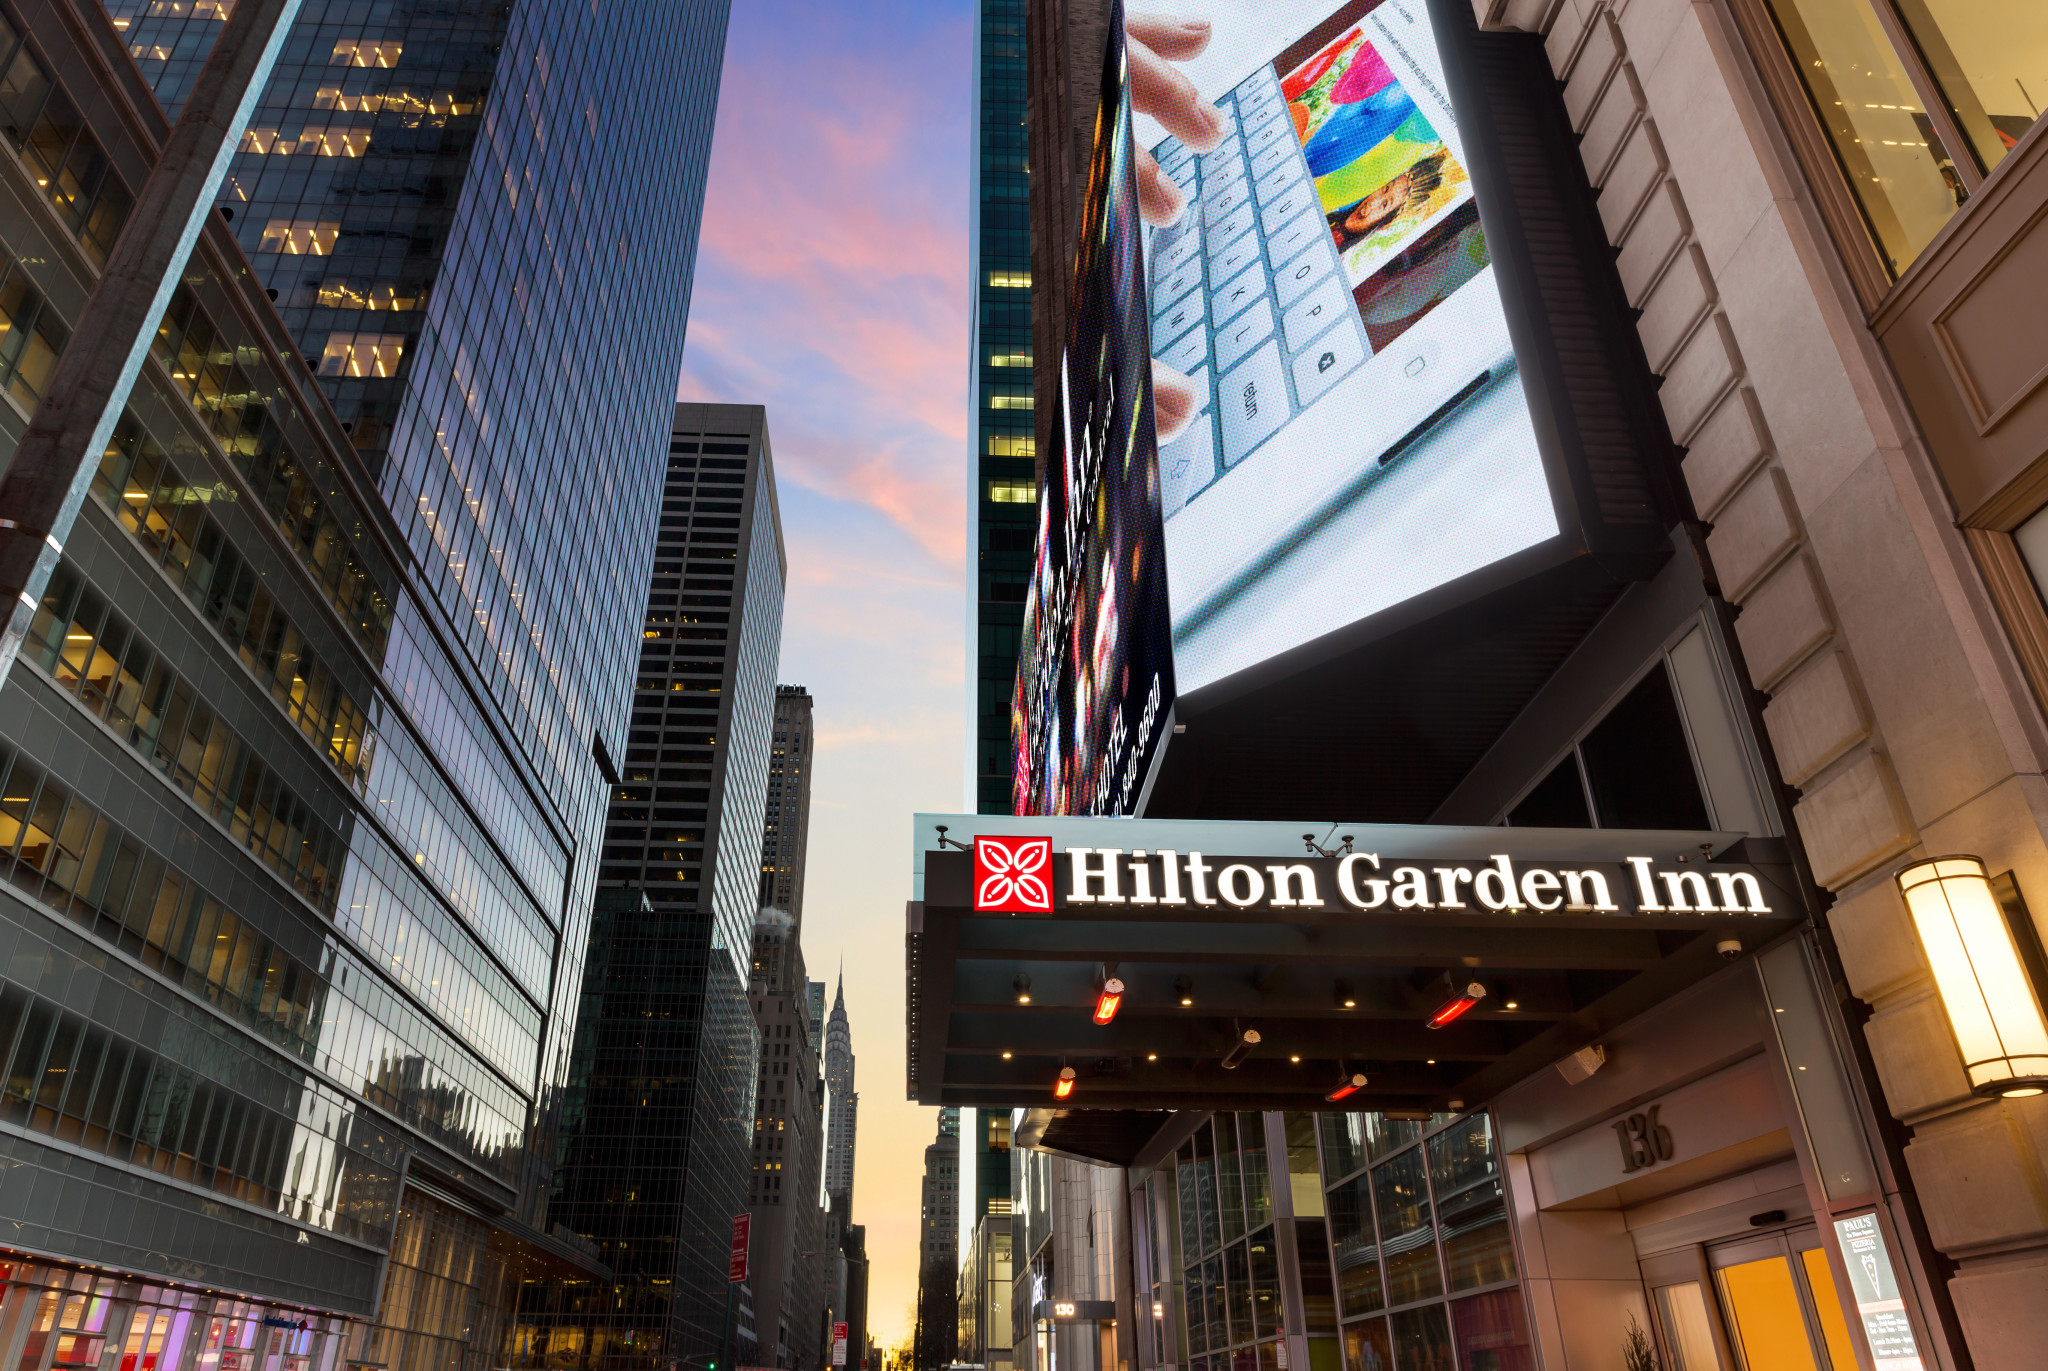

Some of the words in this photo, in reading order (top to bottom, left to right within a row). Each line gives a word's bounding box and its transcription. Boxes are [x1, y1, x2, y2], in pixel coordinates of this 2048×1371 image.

[1231, 286, 1245, 302] K
[1306, 305, 1321, 316] P
[1236, 326, 1250, 342] L
[1243, 381, 1257, 420] return
[1086, 373, 1114, 524] Central
[1029, 565, 1065, 770] Garden
[1097, 703, 1127, 815] HOTEL
[1122, 672, 1160, 807] 840-9600
[1065, 847, 1325, 908] Hilton
[1337, 853, 1619, 912] Garden
[1625, 856, 1772, 914] Inn
[1611, 1104, 1673, 1173] 136
[1843, 1217, 1872, 1232] PAUL'S
[1055, 1304, 1075, 1316] 130
